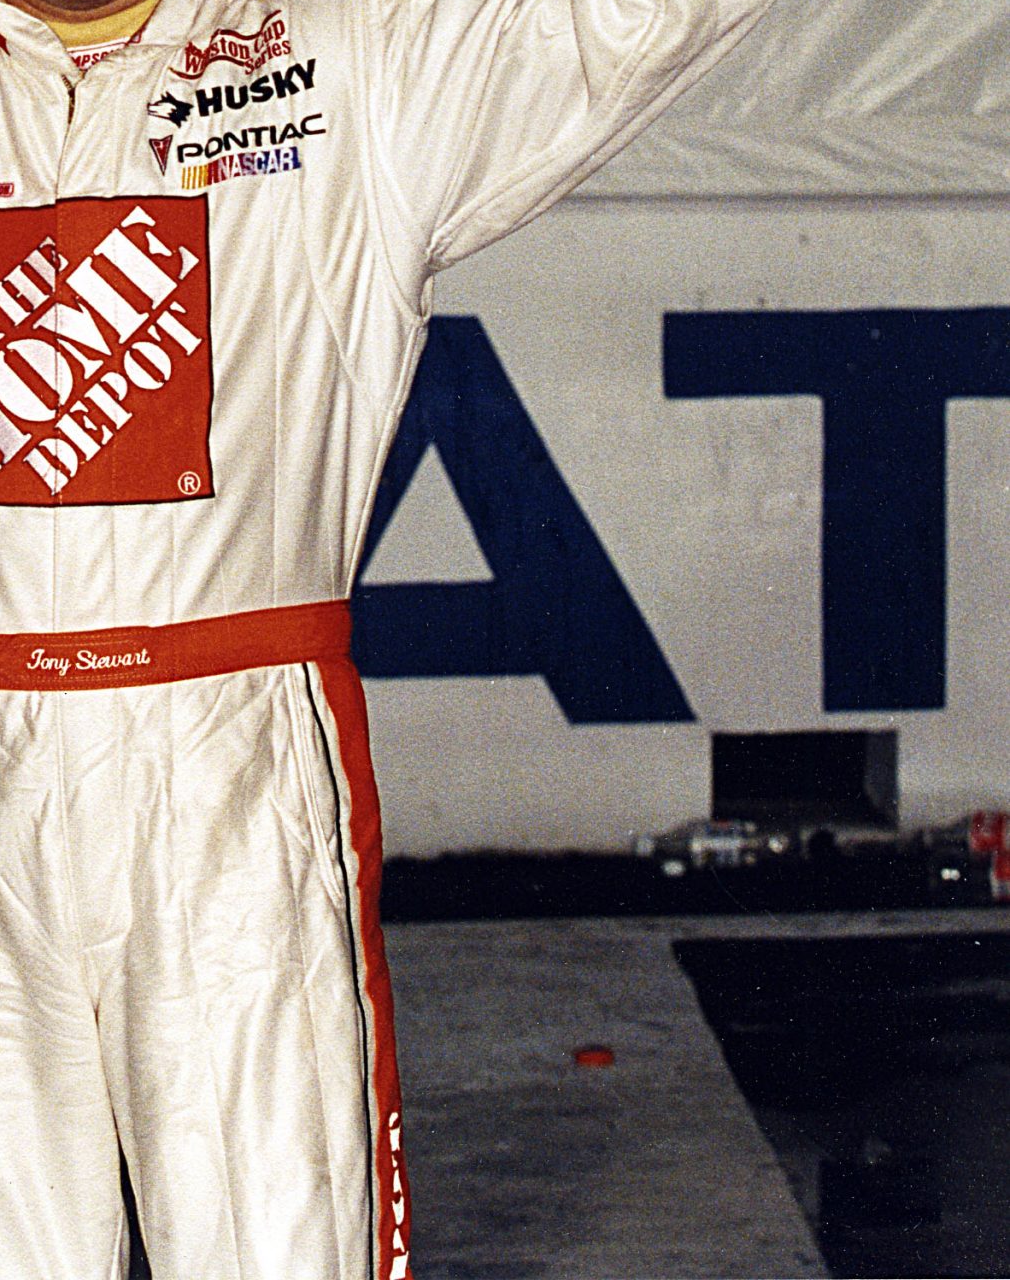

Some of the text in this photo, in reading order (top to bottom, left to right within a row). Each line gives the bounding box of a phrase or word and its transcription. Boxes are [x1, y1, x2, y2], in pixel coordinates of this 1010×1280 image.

[244, 39, 292, 75] Series
[195, 58, 316, 118] HUSKY
[177, 112, 327, 164] PONTIAC
[212, 147, 298, 183] NASCAR
[23, 300, 203, 496] DEPOT
[27, 648, 151, 677] Tony Stewart
